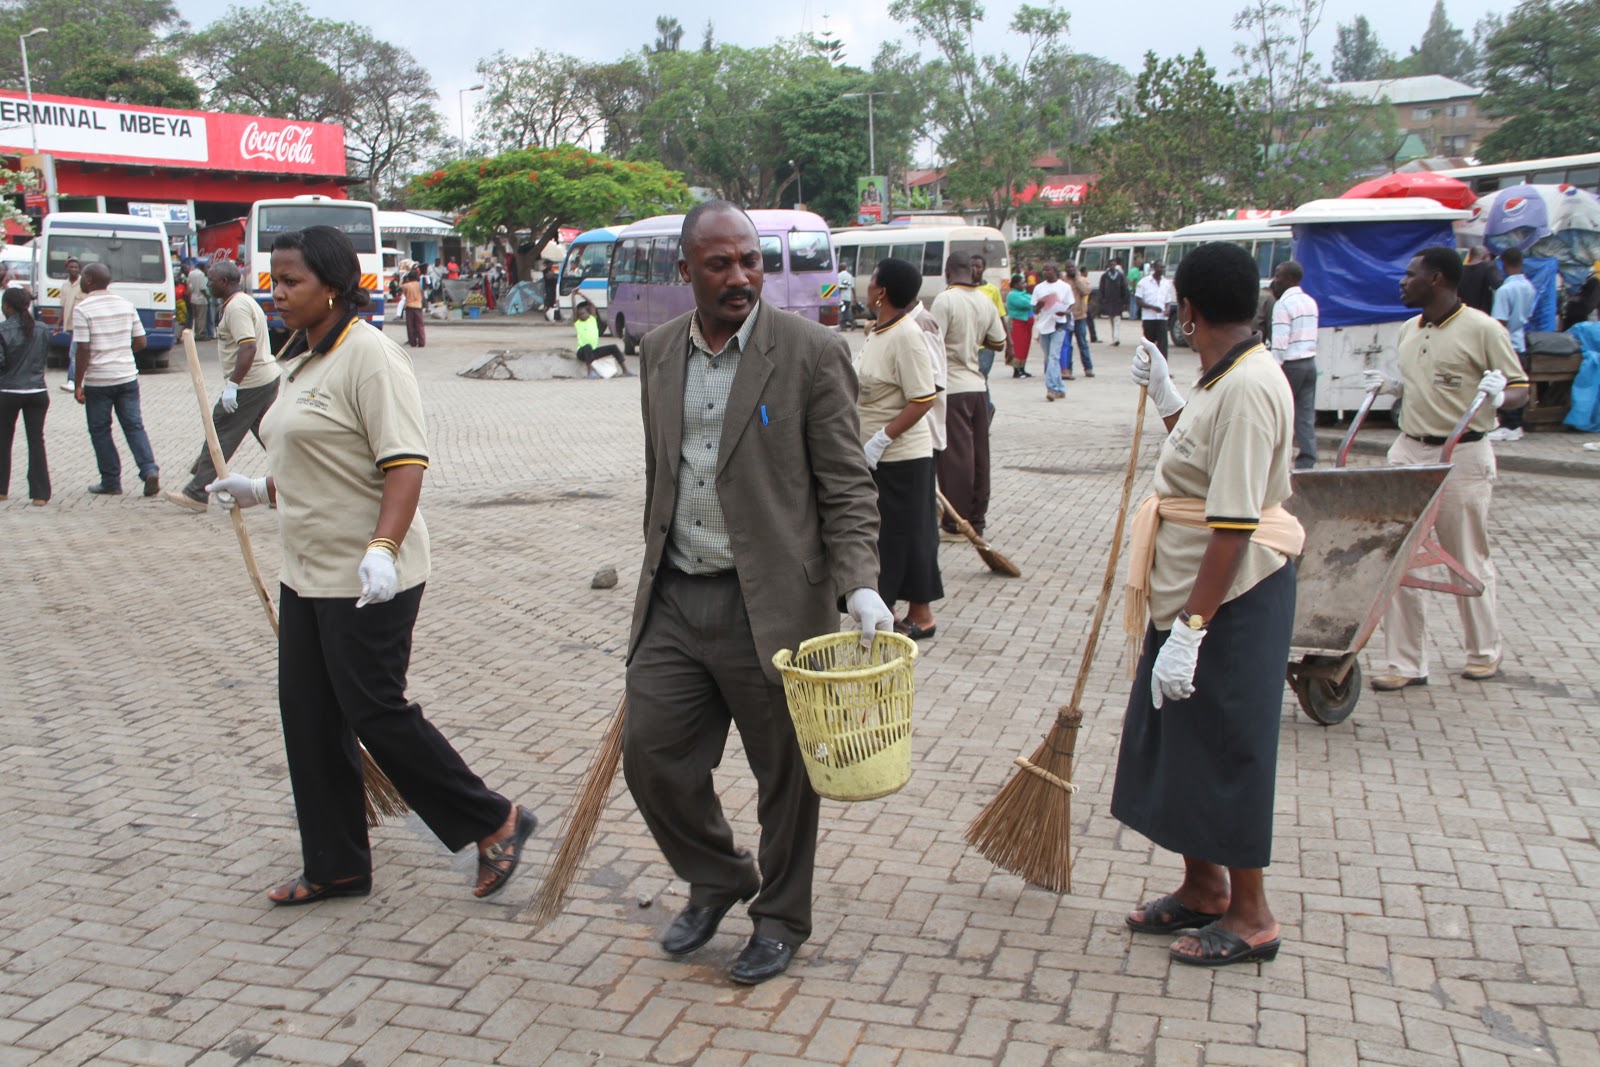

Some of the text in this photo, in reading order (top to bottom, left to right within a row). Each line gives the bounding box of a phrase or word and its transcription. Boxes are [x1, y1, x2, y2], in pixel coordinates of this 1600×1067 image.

[0, 101, 192, 138] ERMINAL MBEYA
[240, 121, 314, 164] Coca-Cola
